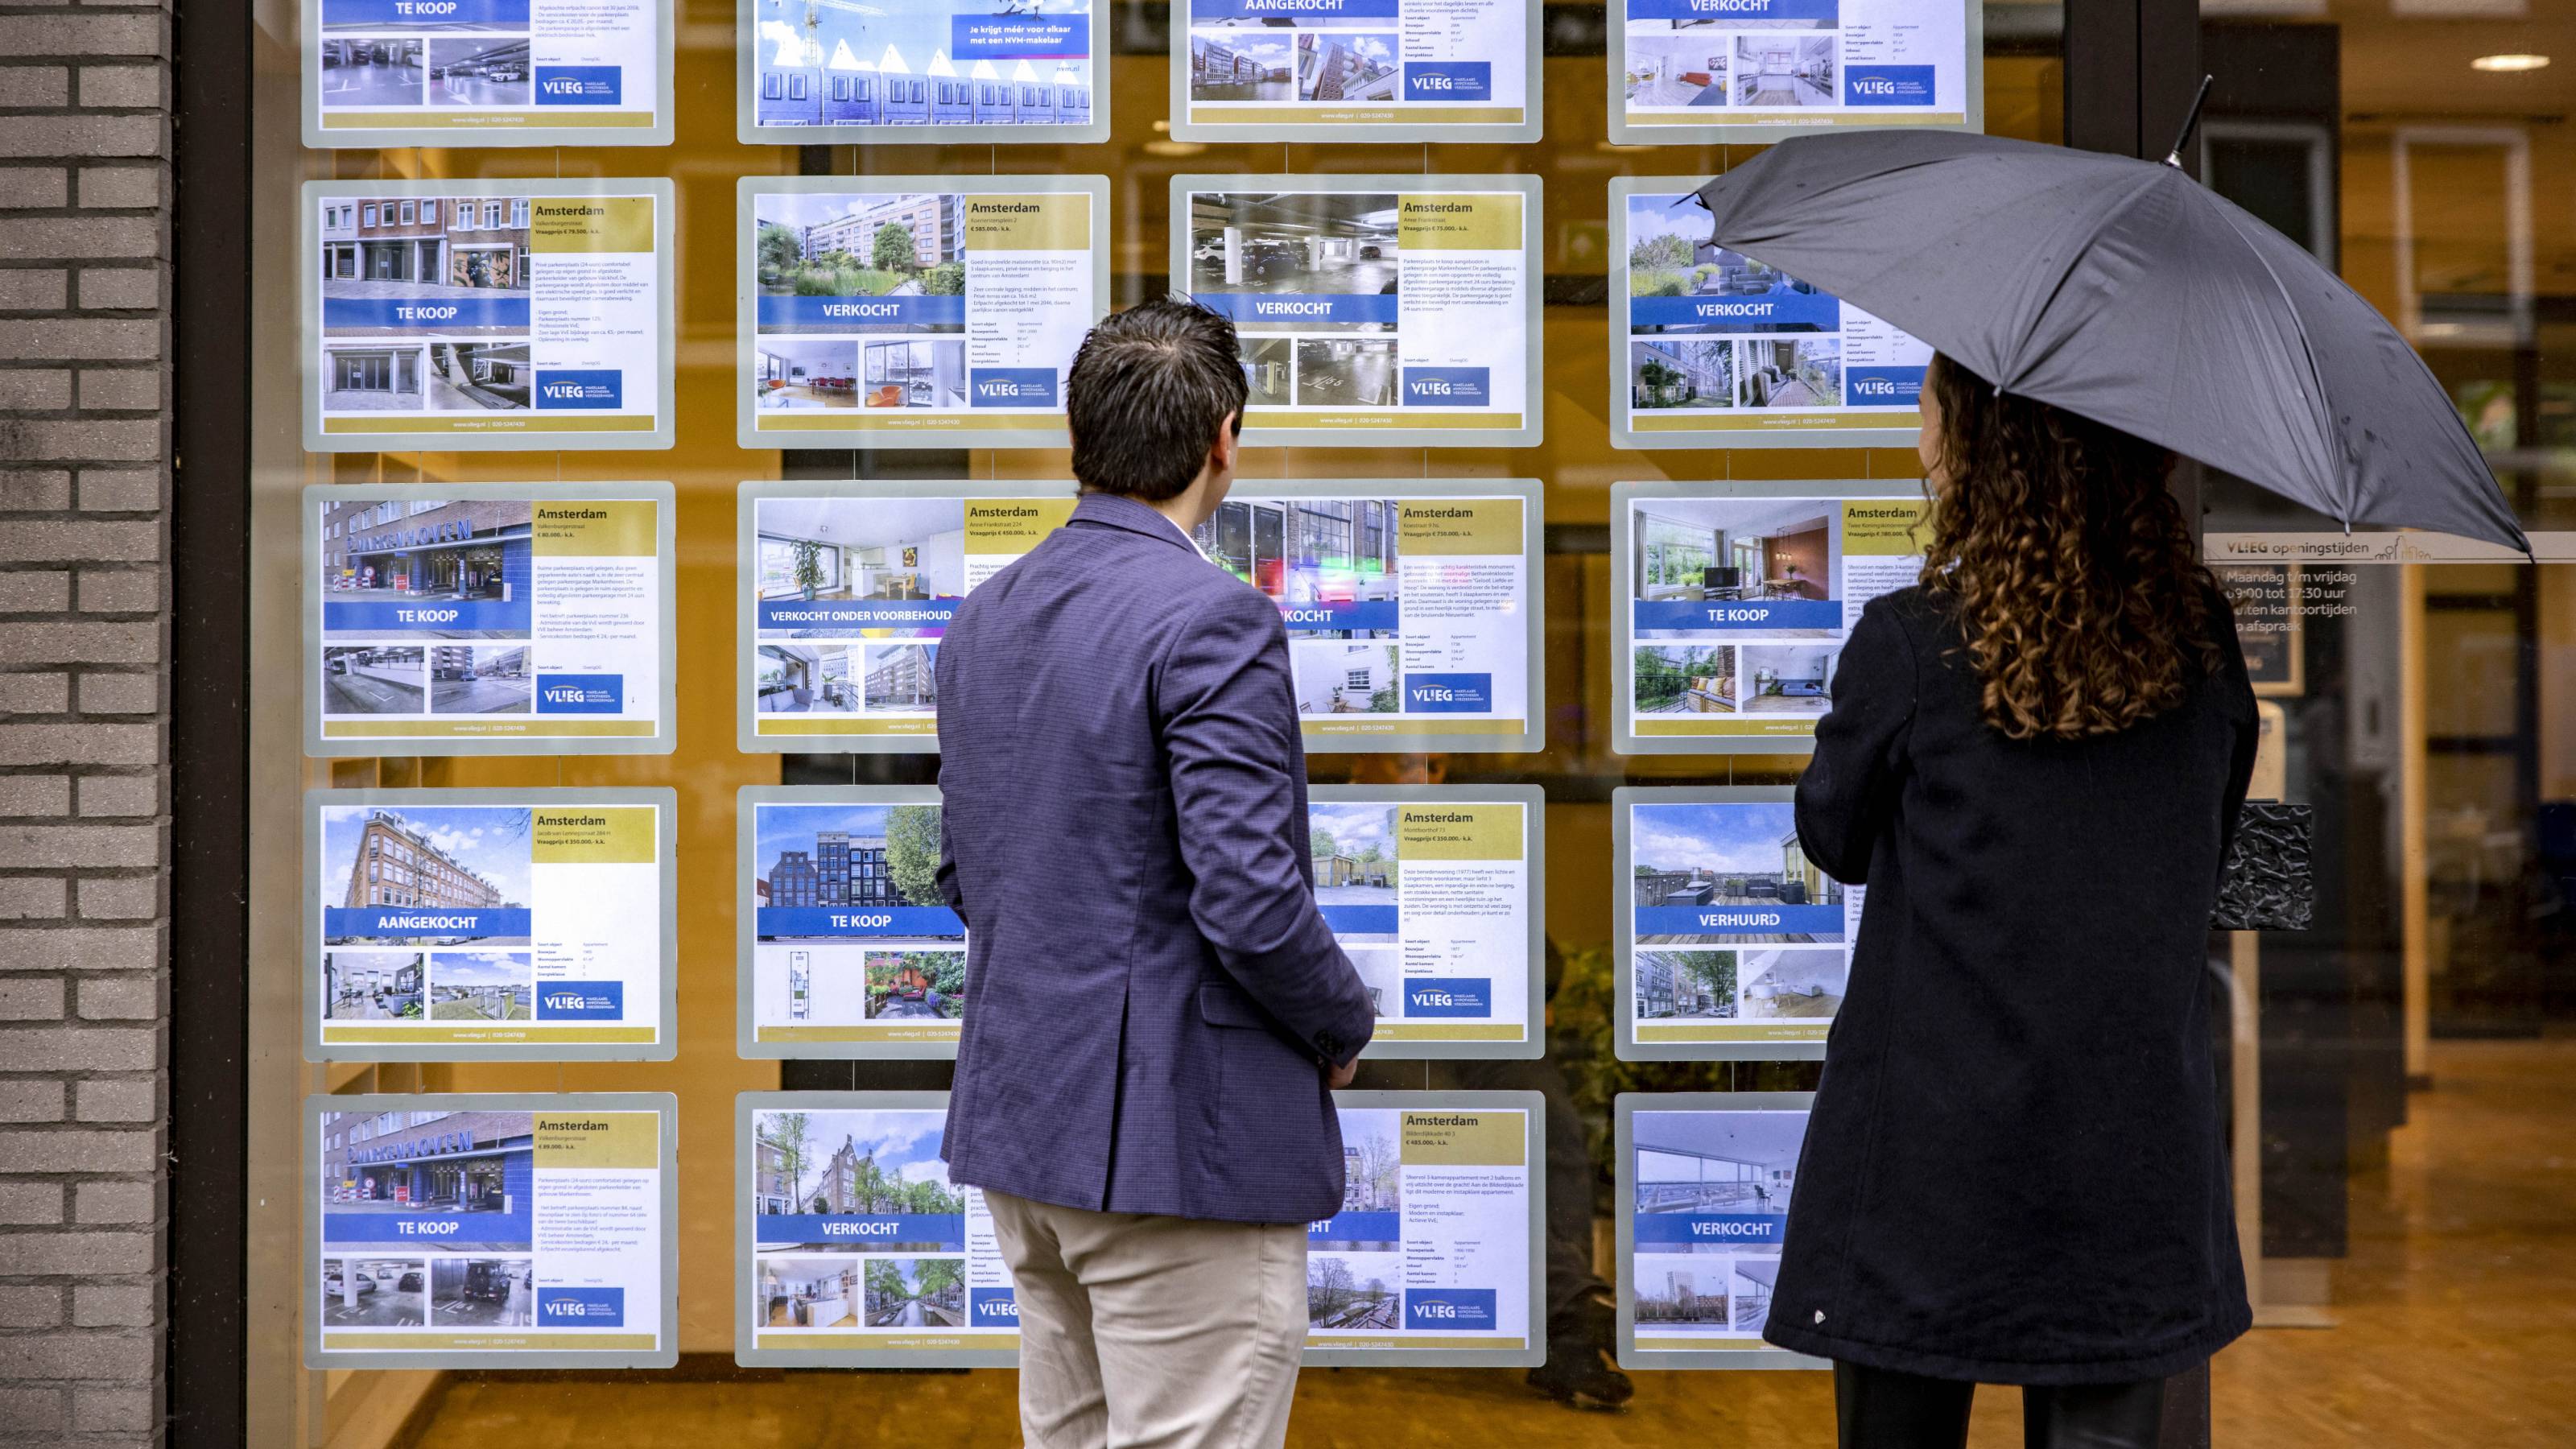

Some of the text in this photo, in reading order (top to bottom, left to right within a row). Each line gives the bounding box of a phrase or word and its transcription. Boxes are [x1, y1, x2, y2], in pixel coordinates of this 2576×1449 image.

[396, 2, 456, 14] TE KOOP
[1245, 0, 1343, 10] AANGEKOCHT
[1690, 0, 1769, 10] VERKOCHT
[980, 26, 1001, 35] krijgt
[1005, 36, 1062, 44] NVM-makelaar
[536, 205, 605, 216] Amsterdam
[971, 203, 1040, 213] Amsterdam
[1404, 202, 1472, 213] Amsterdam
[397, 308, 457, 320] TE KOOP
[824, 304, 899, 316] VERKOCHT
[1257, 303, 1332, 314] VERKOCHT
[1697, 303, 1773, 316] VERKOCHT
[538, 509, 607, 518] Amsterdam
[970, 506, 1038, 517] Amsterdam
[1404, 507, 1473, 518] Amsterdam
[1848, 507, 1917, 518] Amsterdam
[2273, 542, 2369, 556] openingstijden
[2227, 572, 2357, 584] Maandag t/m vrijdag
[2266, 588, 2285, 599] tot
[2289, 588, 2322, 599] 17:30
[2324, 590, 2346, 599] uur
[397, 610, 457, 621] TE KOOP
[771, 611, 952, 621] VERKOCHT ONDER VOORBEHOUD
[1285, 610, 1333, 621] KOCHT
[1707, 609, 1769, 621] TE KOOP
[2271, 604, 2357, 617] kantoortijden
[2247, 620, 2301, 633] afspraak
[537, 815, 605, 826] Amsterdam
[1404, 812, 1473, 823] Amsterdam
[378, 917, 477, 928] AANGEKOCHT
[831, 915, 891, 927] TE KOOP
[1699, 914, 1780, 926] VERHUURD
[539, 1121, 609, 1130] Amsterdam
[1406, 1115, 1478, 1126] Amsterdam
[398, 1222, 458, 1234] TE KOOP
[823, 1223, 899, 1234] VERKOCHT
[1692, 1223, 1773, 1235] VERKOCHT
